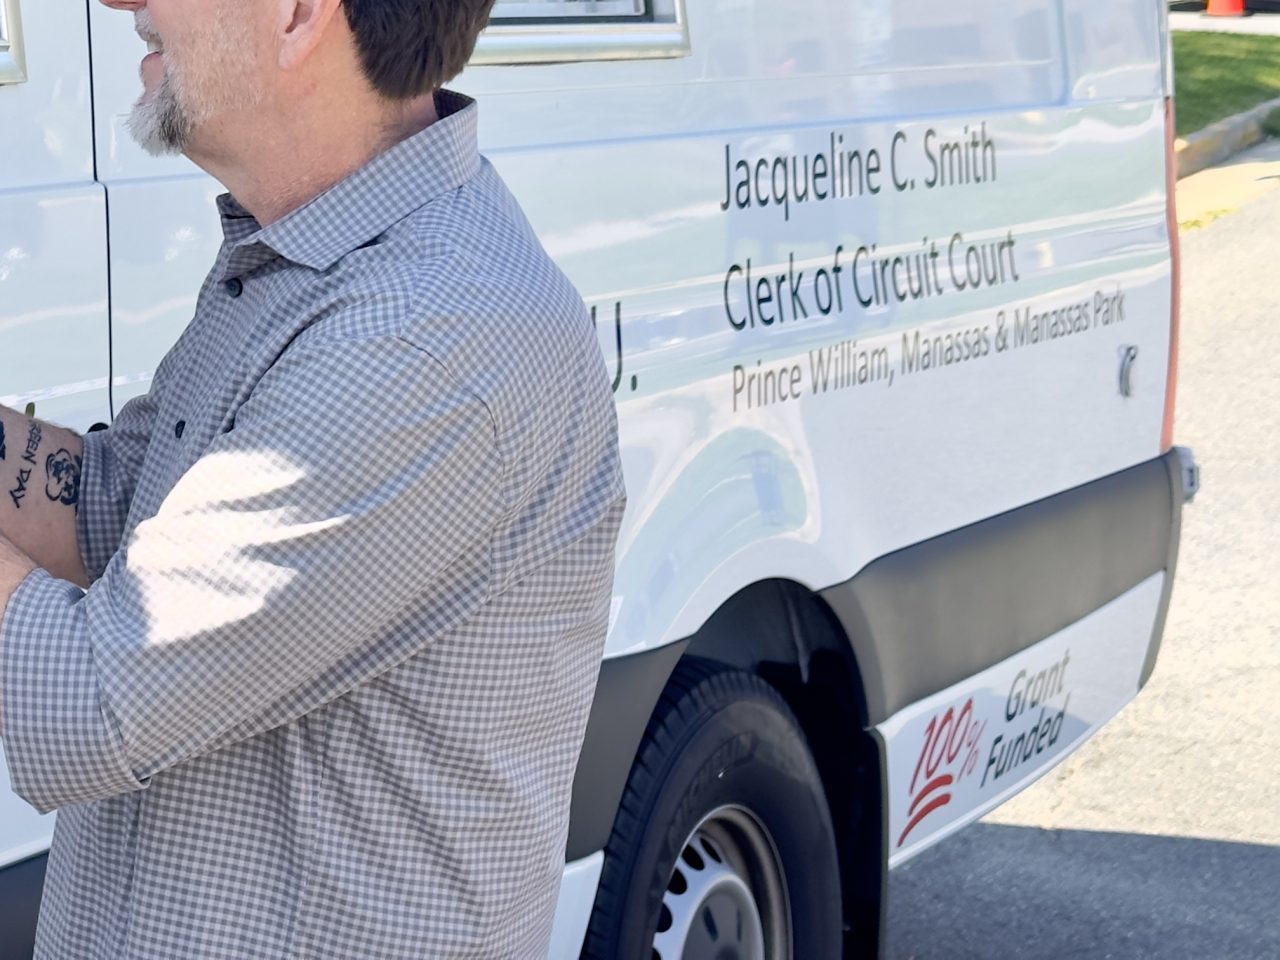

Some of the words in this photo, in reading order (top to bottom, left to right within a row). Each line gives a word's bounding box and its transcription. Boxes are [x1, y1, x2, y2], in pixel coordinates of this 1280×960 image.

[720, 131, 882, 222] Jacqueline
[891, 130, 916, 192] C.
[924, 121, 997, 189] Smith
[723, 252, 808, 332] Clerk
[814, 244, 844, 316] of
[851, 236, 944, 308] Circuit
[948, 229, 1020, 293] Court
[732, 359, 803, 413] Prince
[808, 340, 895, 396] William,
[900, 324, 990, 376] Manassas
[994, 310, 1010, 354] &
[1013, 298, 1091, 351] Manassas
[1093, 282, 1127, 328] Park
[8, 468, 32, 509] DAY
[22, 420, 42, 466] REEN
[1005, 648, 1071, 723] Grant
[980, 692, 1071, 788] Funded
